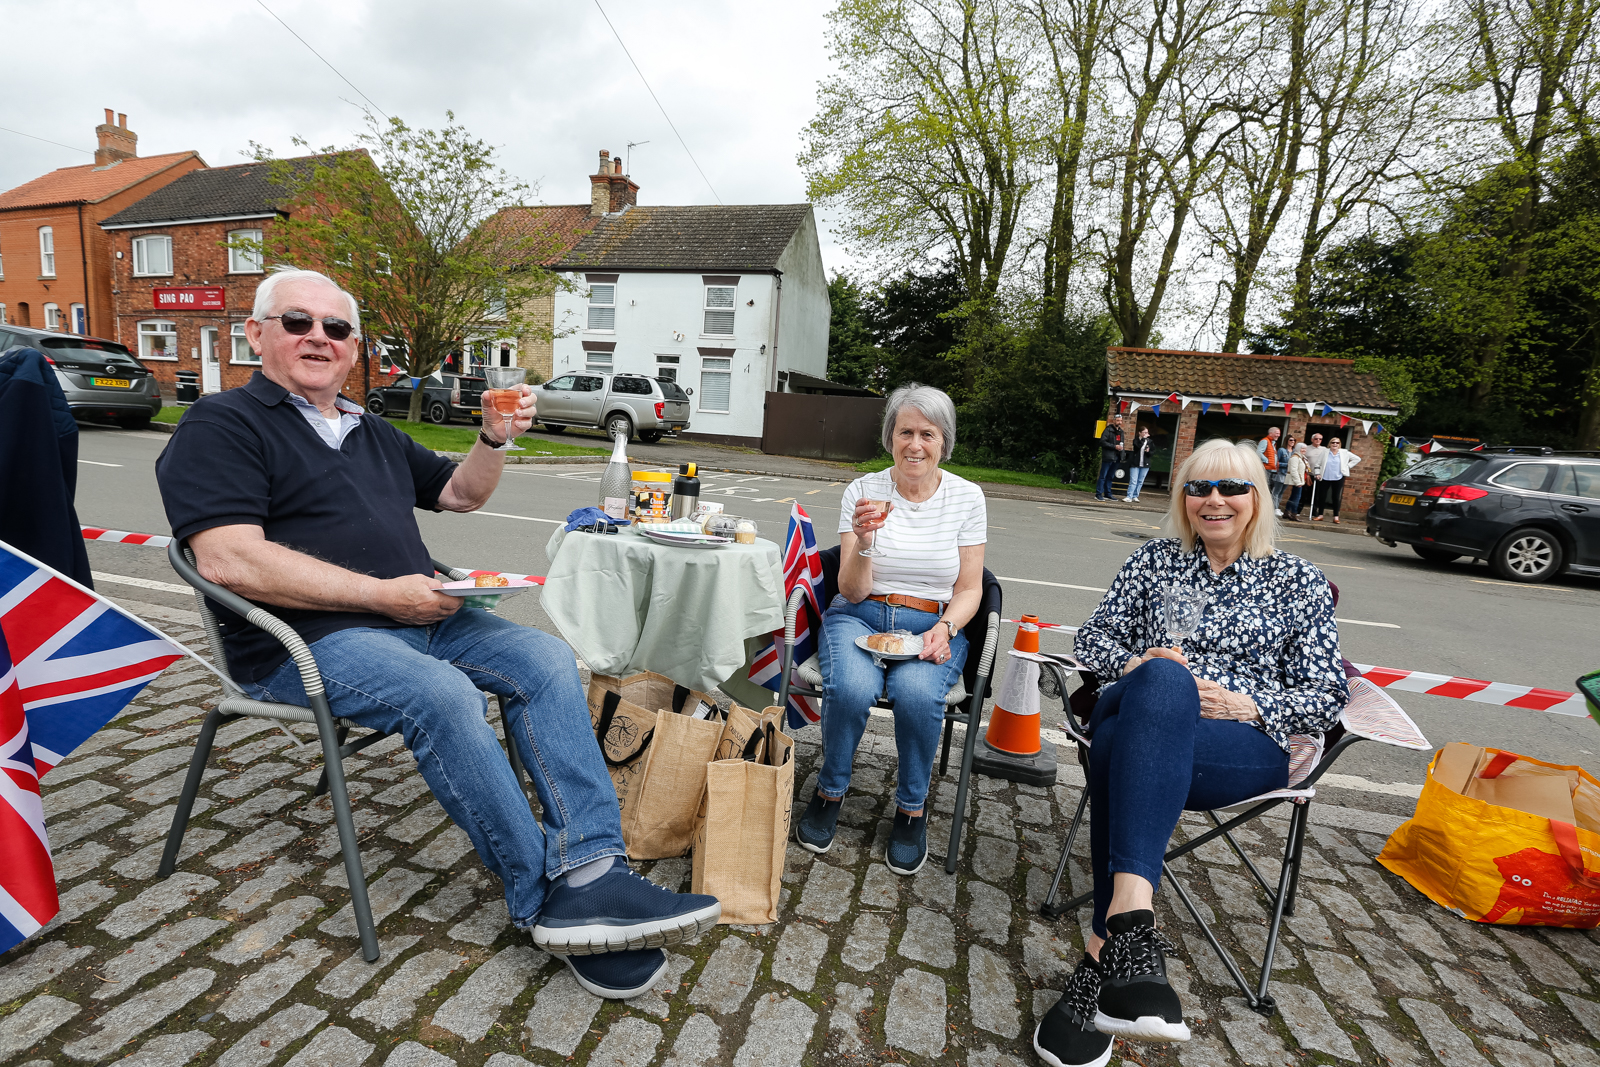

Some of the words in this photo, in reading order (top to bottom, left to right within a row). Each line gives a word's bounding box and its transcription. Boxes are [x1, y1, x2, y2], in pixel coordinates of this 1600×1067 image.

[159, 293, 176, 304] SING
[179, 293, 195, 304] PAO
[95, 378, 112, 386] FX22
